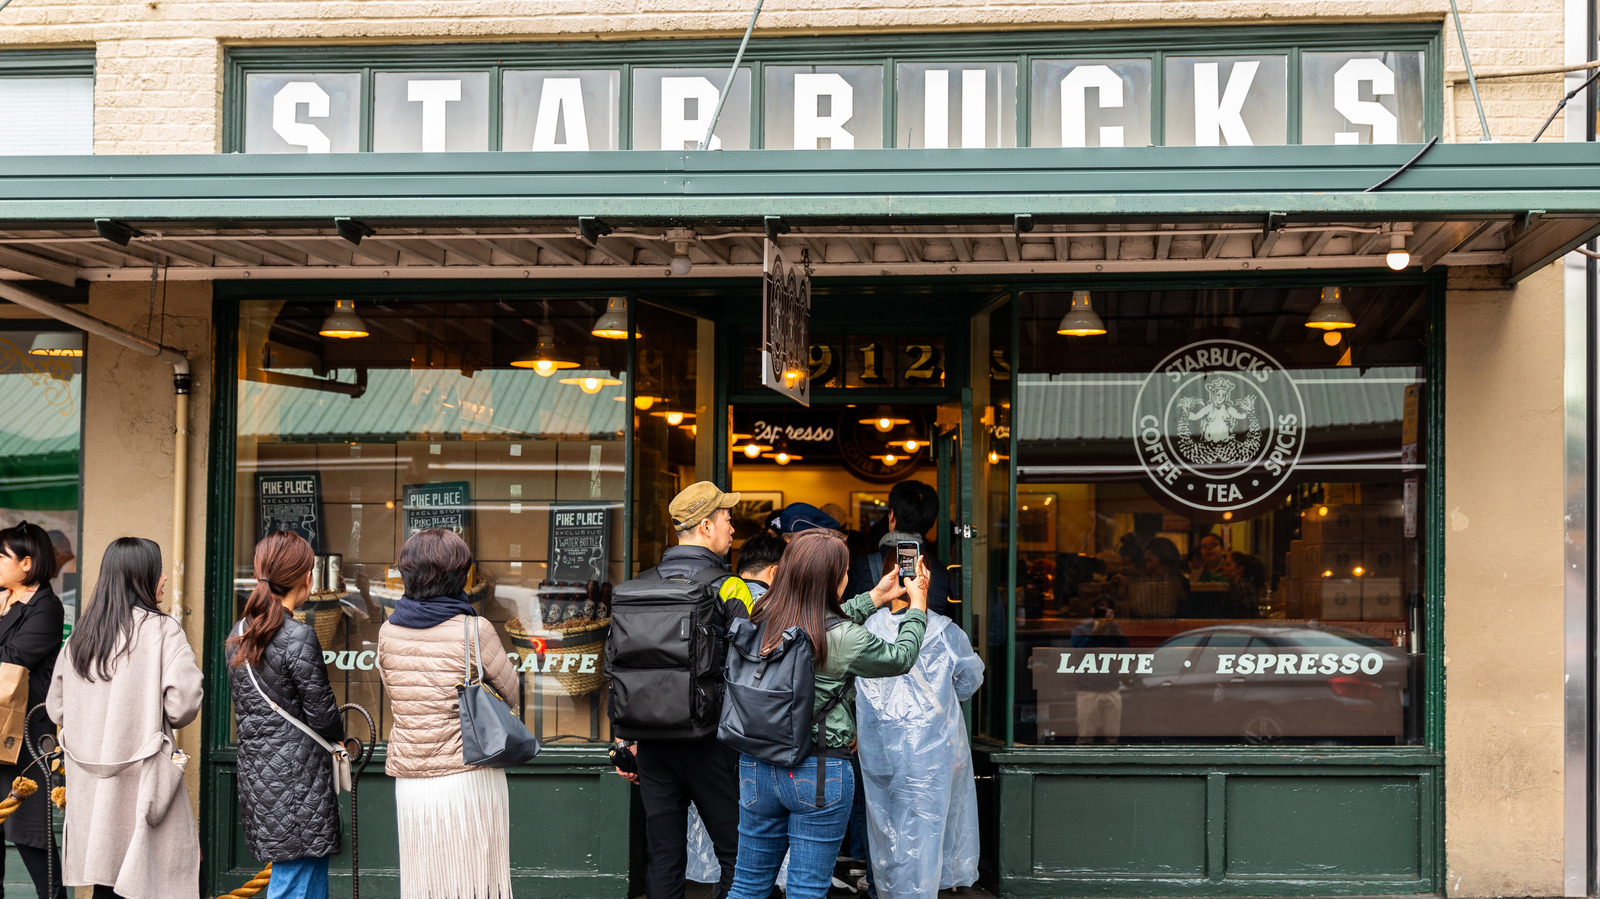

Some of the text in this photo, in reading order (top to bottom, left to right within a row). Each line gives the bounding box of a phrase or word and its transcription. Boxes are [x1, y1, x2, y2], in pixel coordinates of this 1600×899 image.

[272, 58, 1398, 154] STARBUCKS
[757, 343, 935, 381] 912
[1164, 347, 1273, 383] STARBUCKS
[1140, 414, 1182, 486] COFFEE
[1263, 413, 1298, 477] SPICES
[262, 480, 314, 495] PIKE PLACE
[1205, 483, 1244, 503] TEA
[410, 491, 461, 507] PIKE PLACE
[410, 509, 461, 517] EXCLUSIVE
[414, 516, 457, 528] PIKE PLACE
[555, 512, 603, 526] PIKE PLACE
[558, 537, 599, 548] WATER BOTTLE
[322, 650, 379, 670] PUC
[1056, 652, 1384, 676] LATTE ESPRESSO
